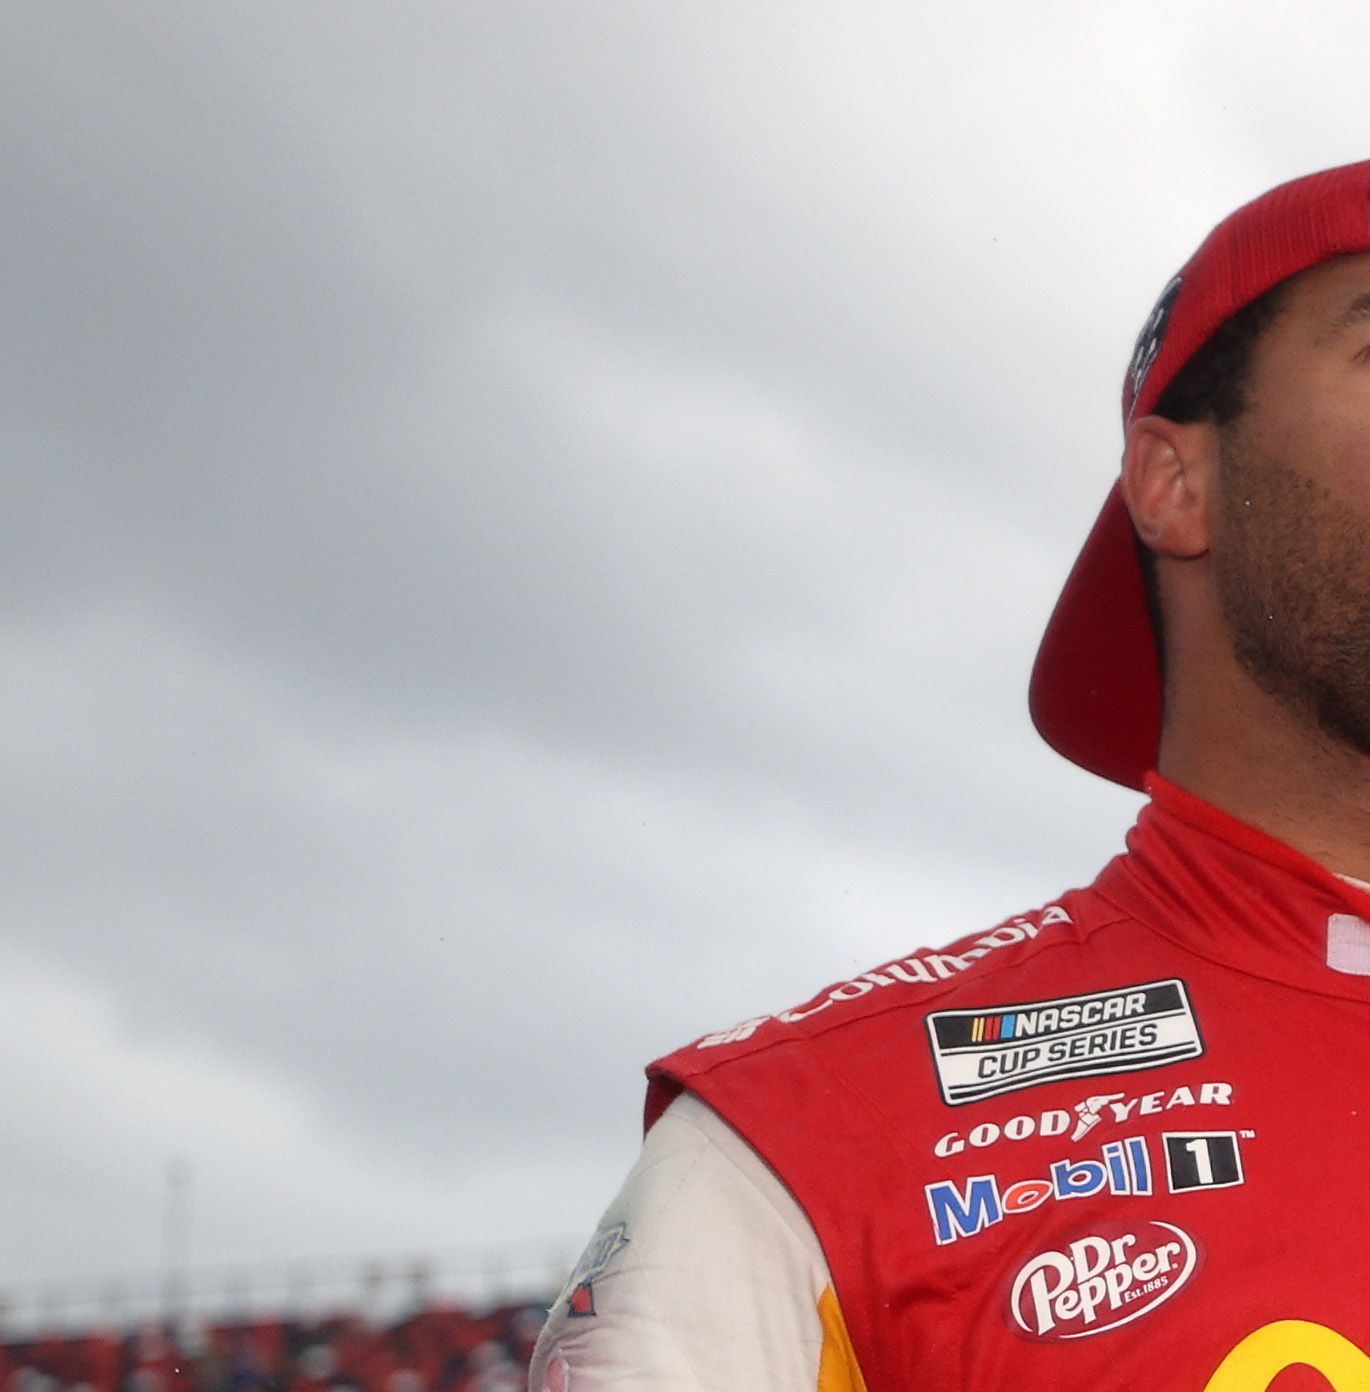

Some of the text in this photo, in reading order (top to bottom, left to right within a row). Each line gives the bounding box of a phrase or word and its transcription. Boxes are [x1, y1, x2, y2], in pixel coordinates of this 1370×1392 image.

[1015, 992, 1146, 1037] NASCAR
[977, 1023, 1158, 1079] CUP SERIES
[934, 1082, 1233, 1157] GOODYEAR
[925, 1136, 1153, 1245] Mobil
[1012, 1242, 1181, 1336] Pepper
[1069, 1233, 1136, 1284] Dr
